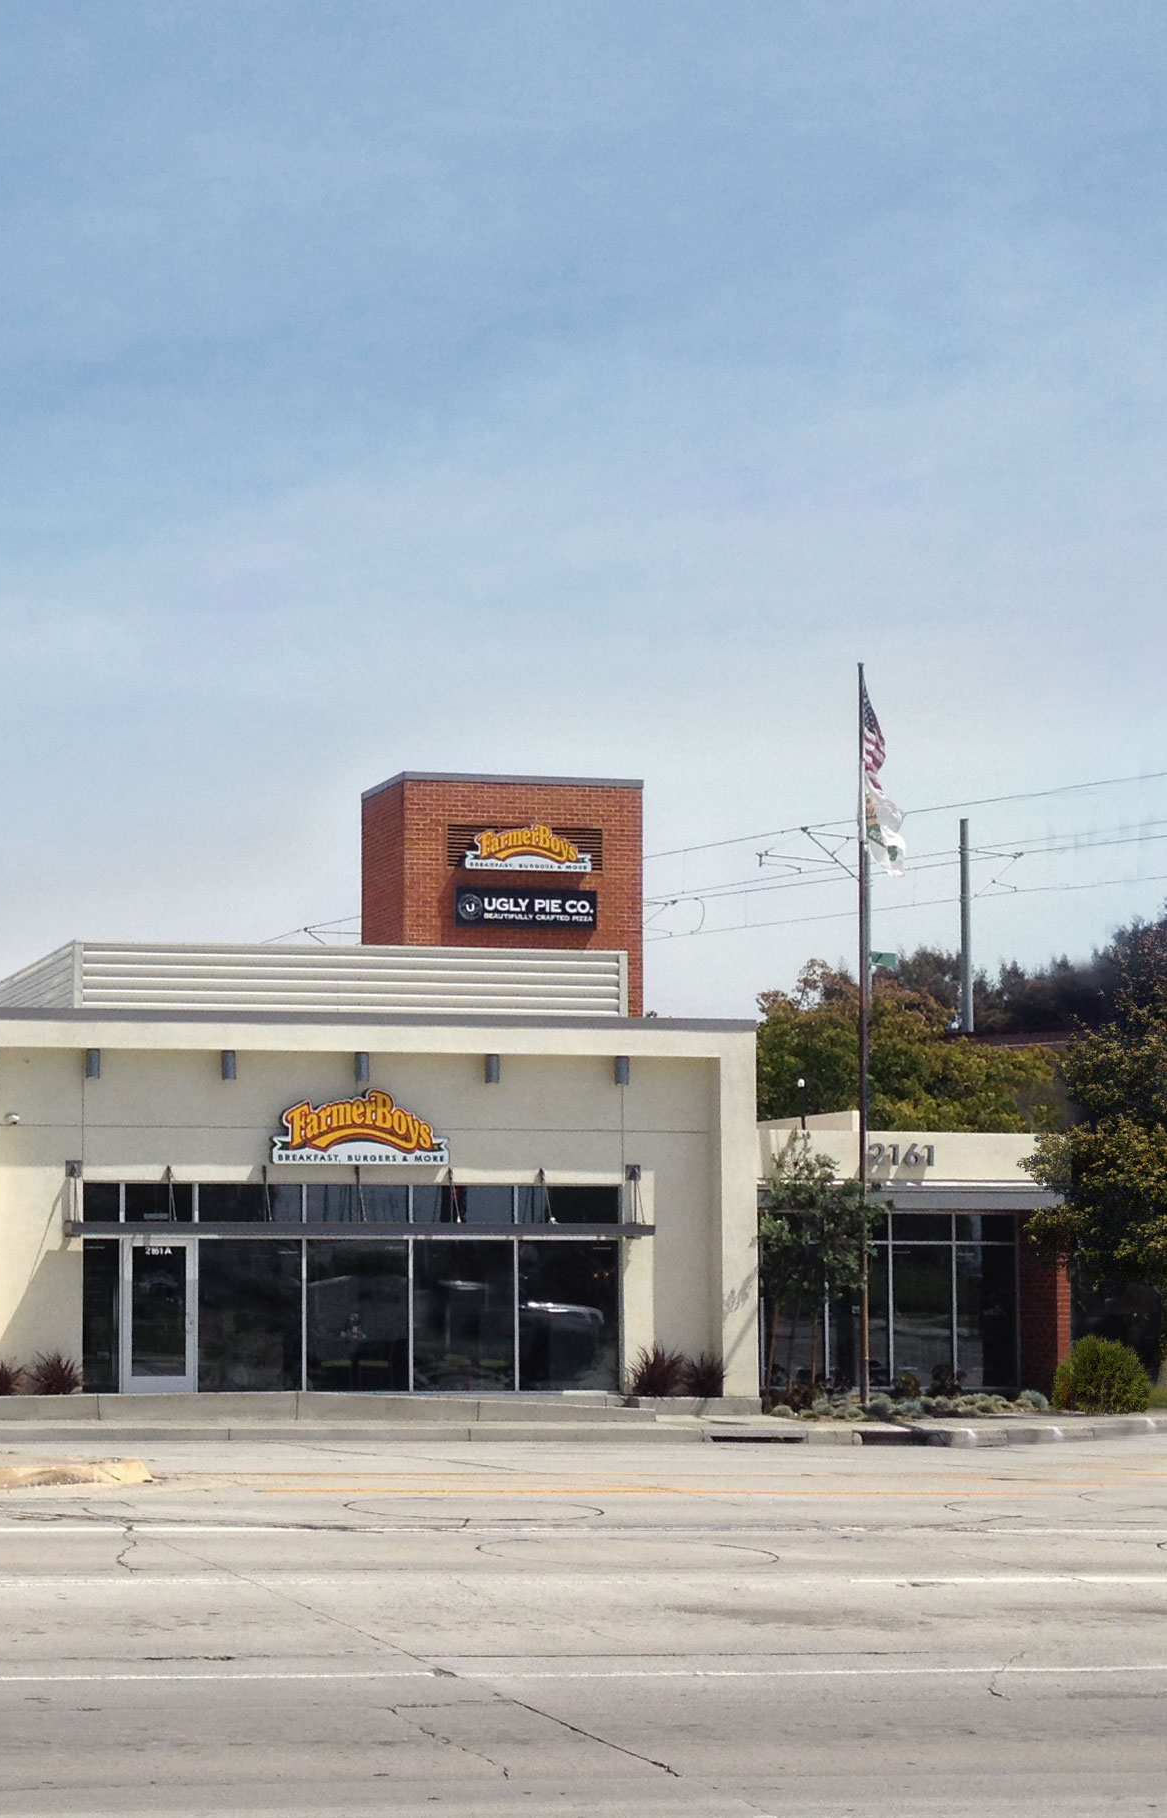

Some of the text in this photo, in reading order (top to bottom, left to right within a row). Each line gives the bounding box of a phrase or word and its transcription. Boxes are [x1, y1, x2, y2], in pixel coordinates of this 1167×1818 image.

[483, 897, 594, 914] UGLY PIE CO.
[277, 1154, 341, 1163] BREAKFAST,
[347, 1154, 396, 1162] BURGERS
[868, 1143, 934, 1167] 2161
